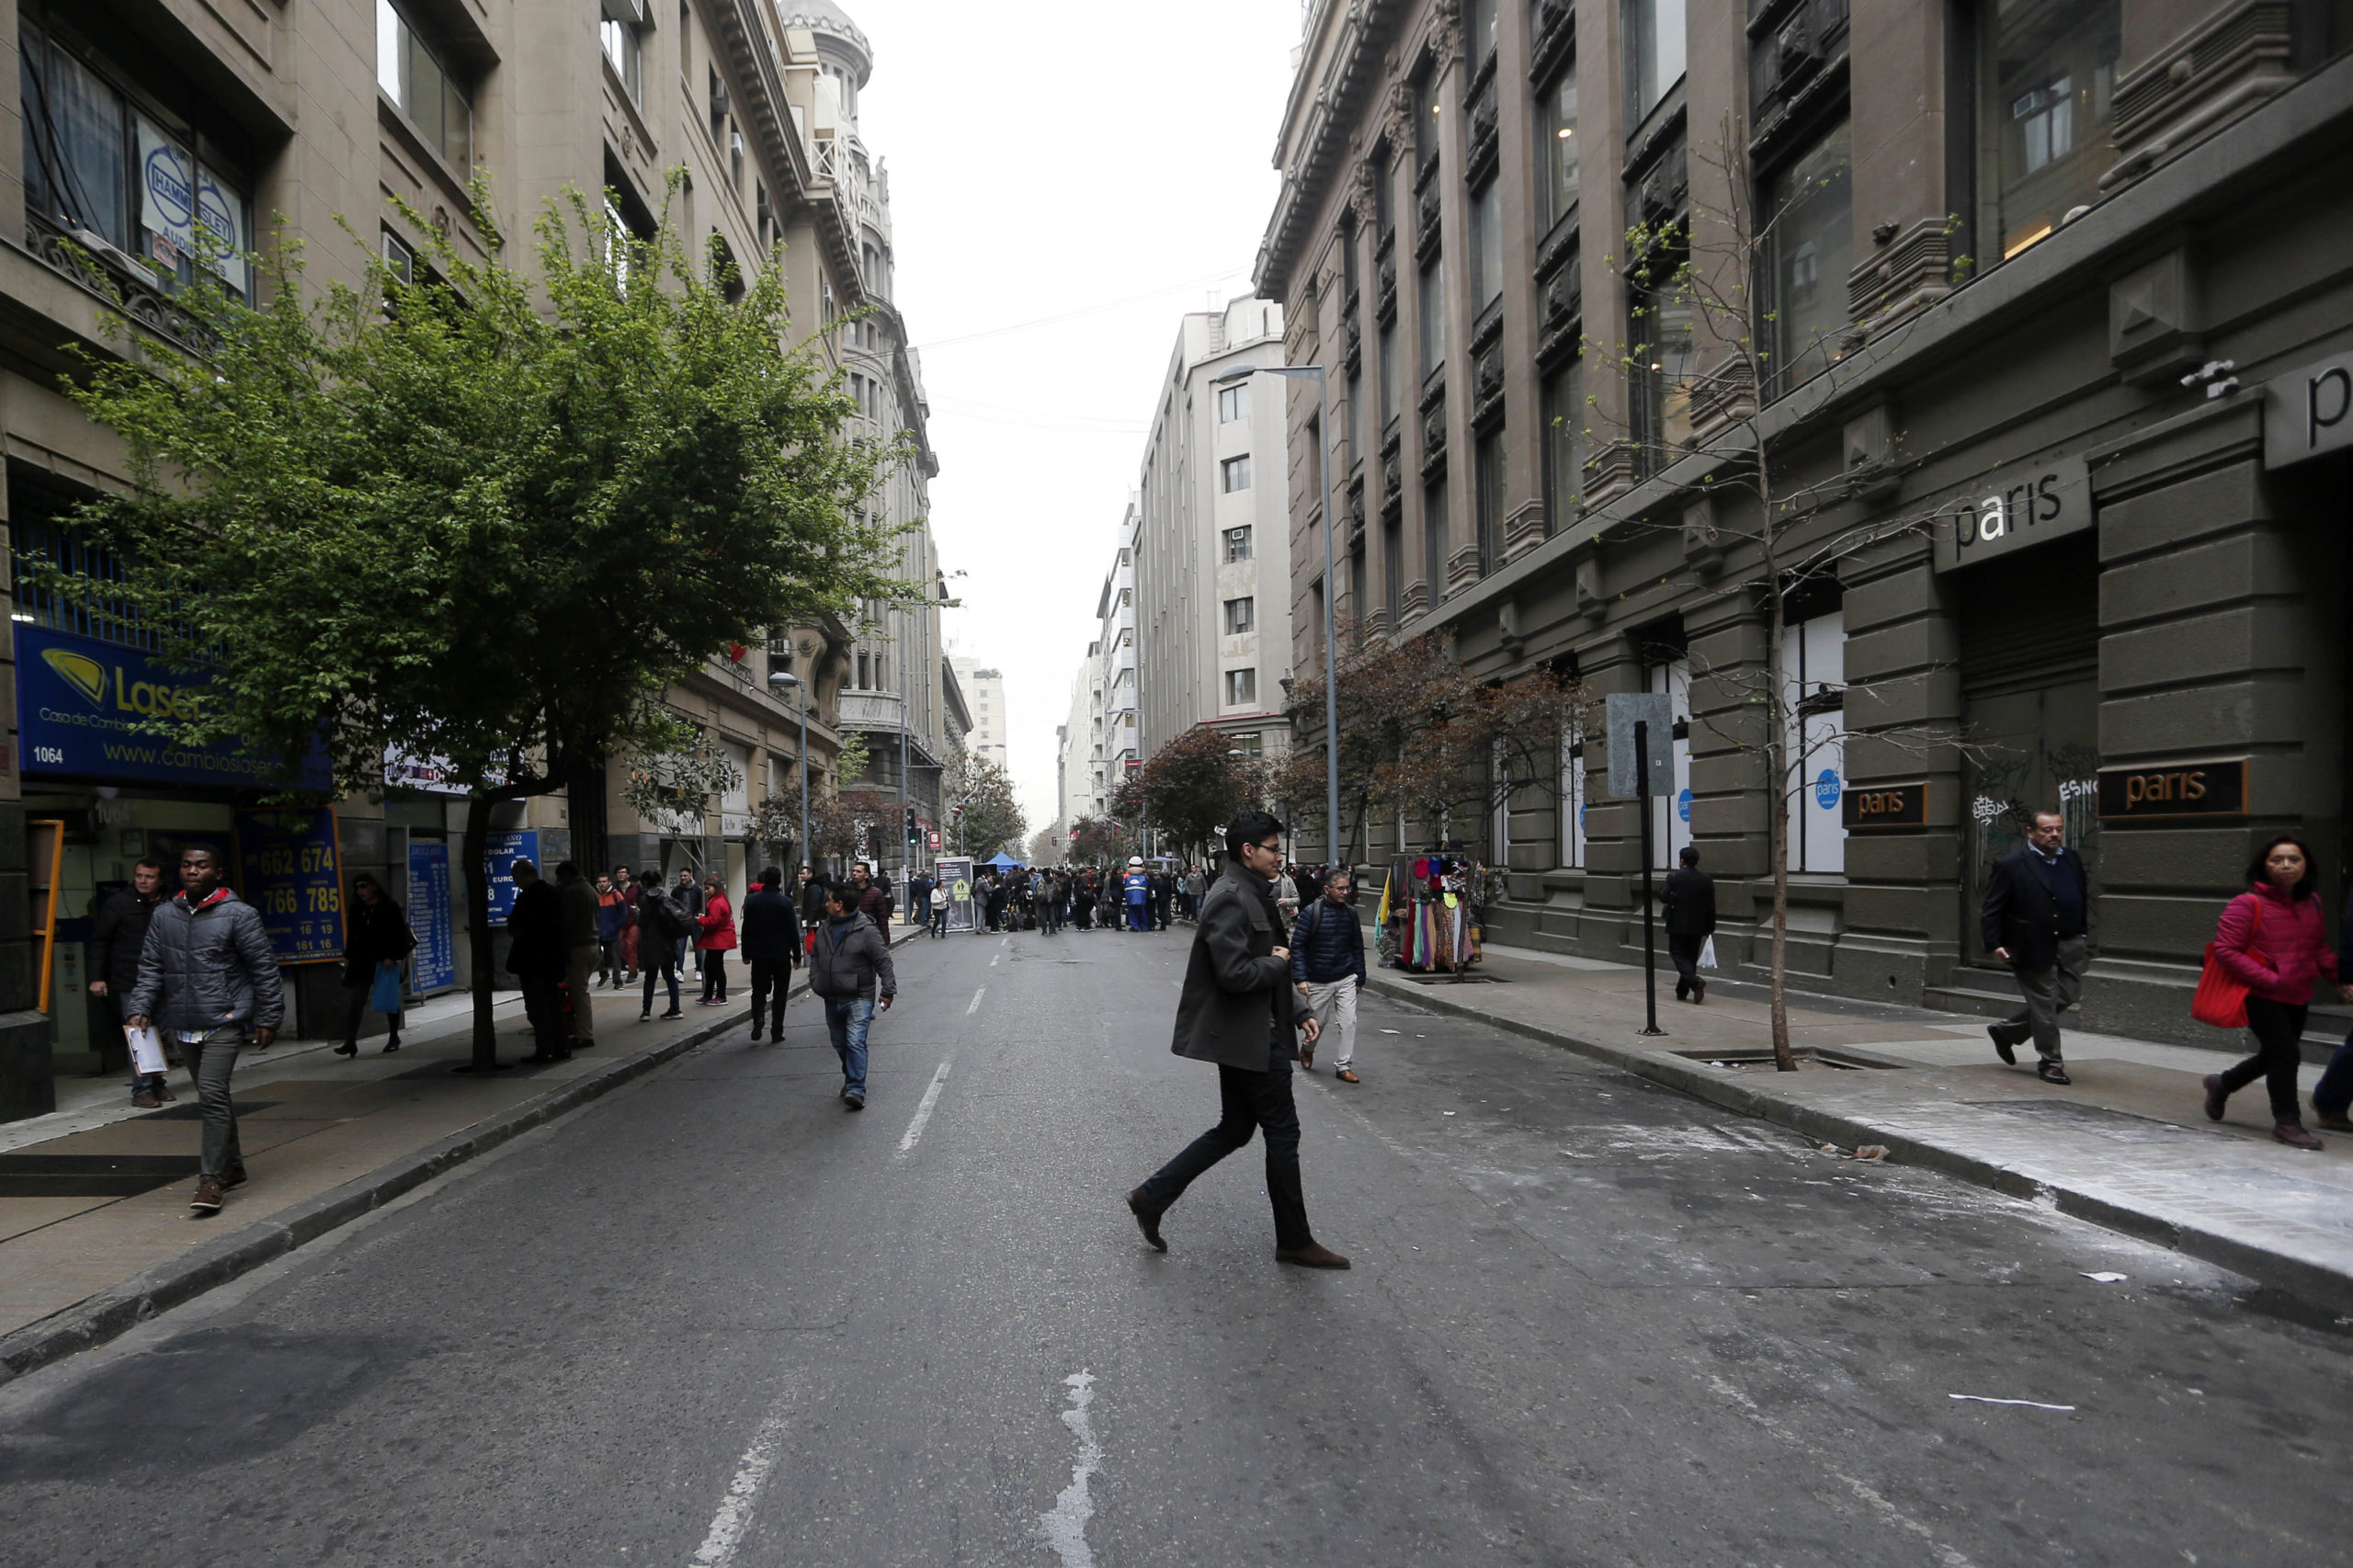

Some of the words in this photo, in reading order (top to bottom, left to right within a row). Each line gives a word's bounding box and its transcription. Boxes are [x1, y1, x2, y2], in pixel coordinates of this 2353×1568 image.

[1955, 474, 2061, 562] paris
[34, 746, 63, 764] 1064
[1817, 783, 1838, 799] paris
[2126, 771, 2207, 810] paris
[1859, 791, 1904, 820] paris
[261, 849, 294, 875] 662
[301, 846, 334, 873] 674
[263, 888, 298, 915] 766
[306, 887, 339, 913] 785
[300, 924, 313, 935] 16
[321, 923, 333, 935] 19
